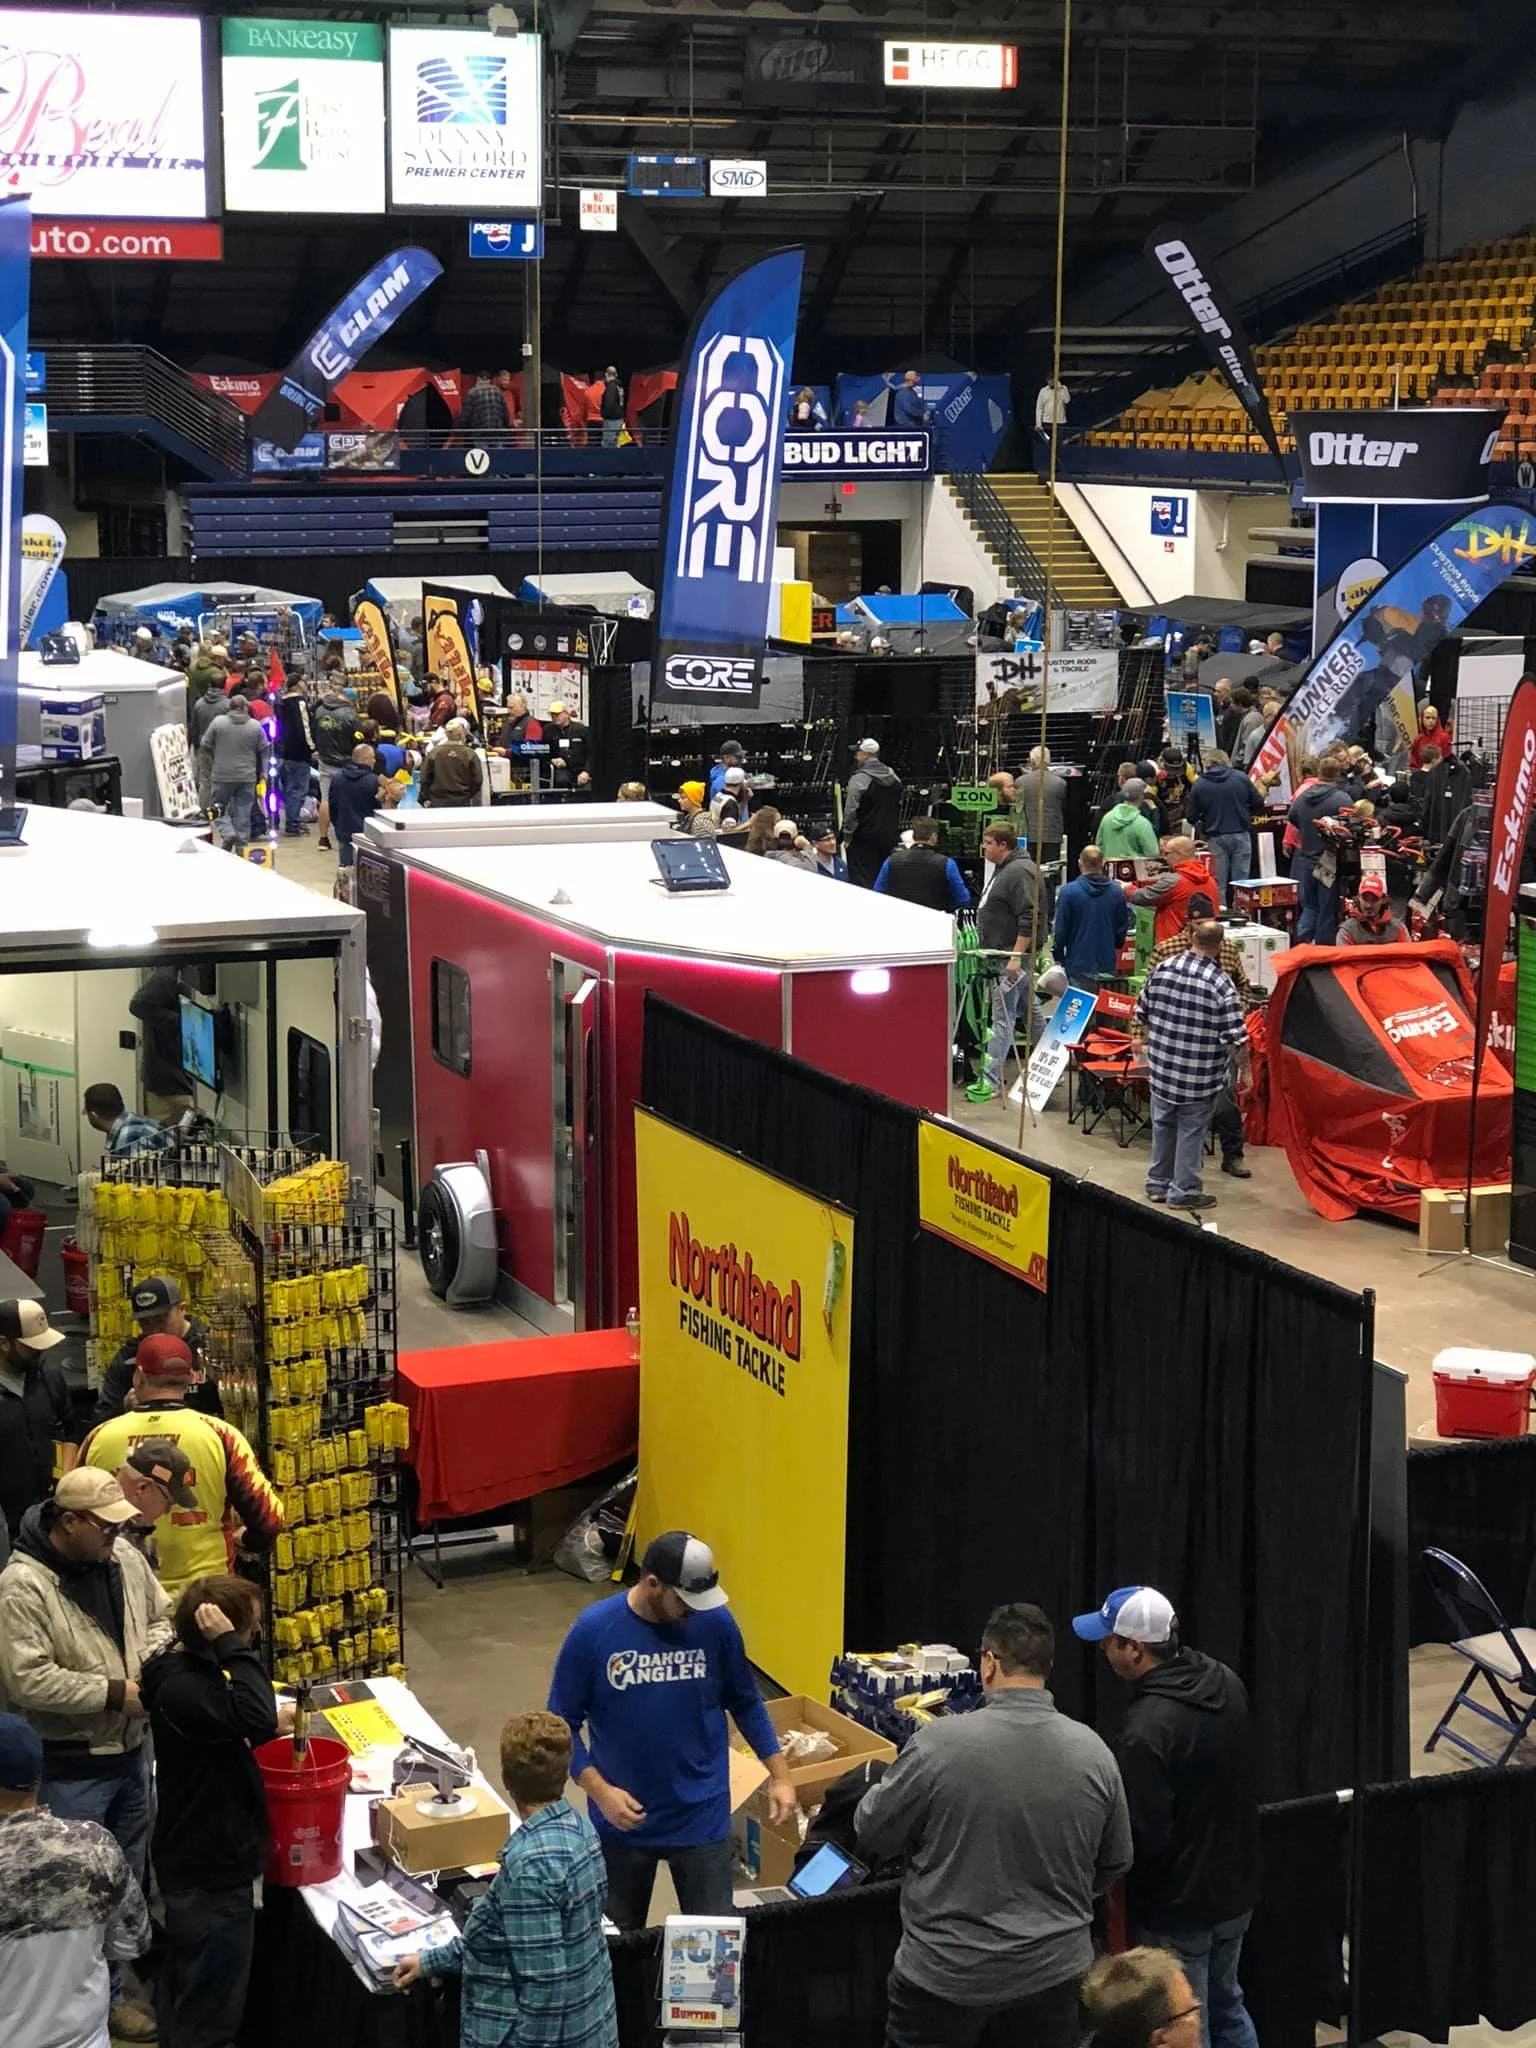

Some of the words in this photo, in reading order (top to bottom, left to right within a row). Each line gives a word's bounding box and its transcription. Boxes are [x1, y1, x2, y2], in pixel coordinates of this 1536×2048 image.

[248, 28, 359, 57] BANKeasy
[404, 166, 467, 178] PREMIER
[470, 167, 526, 179] CENTER
[721, 171, 754, 186] SMG
[582, 203, 616, 215] SMOKING
[593, 191, 604, 202] NO
[31, 226, 172, 255] uto.com
[473, 222, 512, 234] PEPSI
[521, 224, 536, 253] J
[1154, 239, 1232, 339] Otter
[339, 260, 411, 349] CLAM
[208, 375, 261, 392] Eskimo
[692, 333, 774, 582] CORE
[783, 441, 841, 465] BUD
[1309, 431, 1419, 468] Otter
[665, 656, 755, 690] CORE
[1332, 653, 1365, 695] RODS
[957, 791, 992, 802] ION
[1493, 728, 1536, 894] Eskimo
[948, 1154, 1019, 1219] Northland
[954, 1193, 982, 1219] FISHING
[983, 1207, 1011, 1233] TACKLE
[668, 1211, 801, 1363] Northland
[679, 1300, 731, 1361] FISHING
[735, 1335, 785, 1398] TACKLE
[638, 1648, 706, 1668] DAKOTA
[622, 1662, 707, 1686] ANGLER
